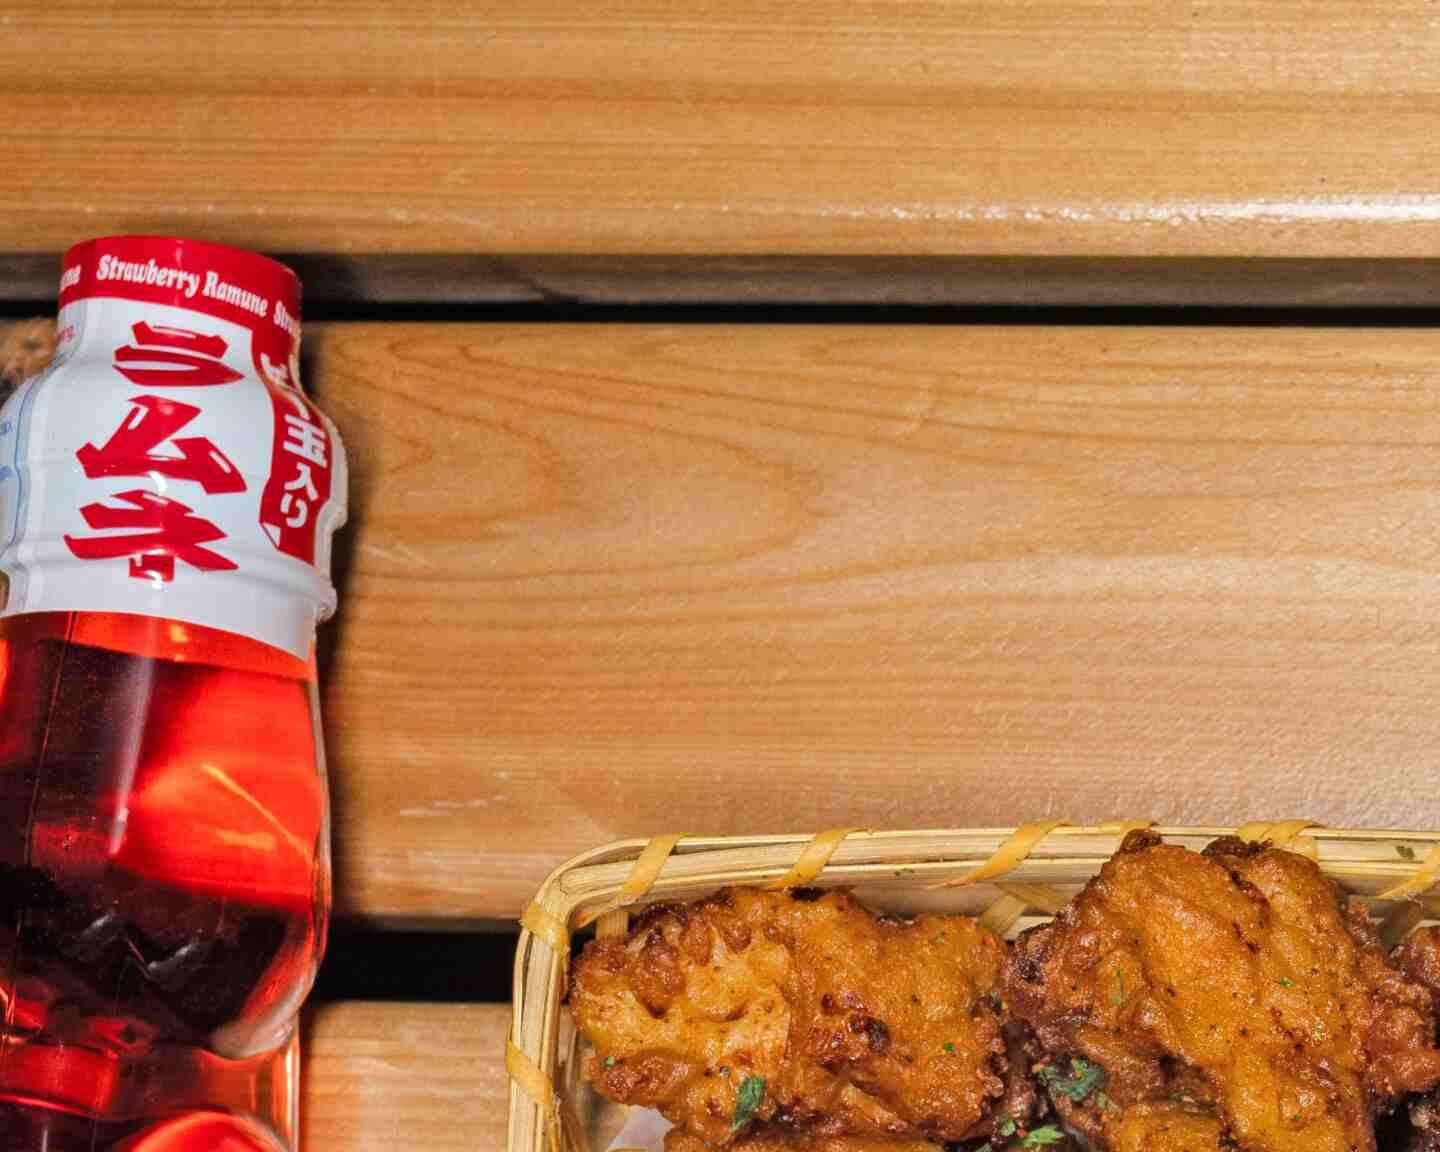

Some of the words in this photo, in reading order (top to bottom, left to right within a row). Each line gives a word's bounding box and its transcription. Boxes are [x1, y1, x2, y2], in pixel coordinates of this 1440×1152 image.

[96, 254, 200, 299] Strawberry
[202, 271, 268, 318] Ramune
[64, 320, 248, 583] ラムネ
